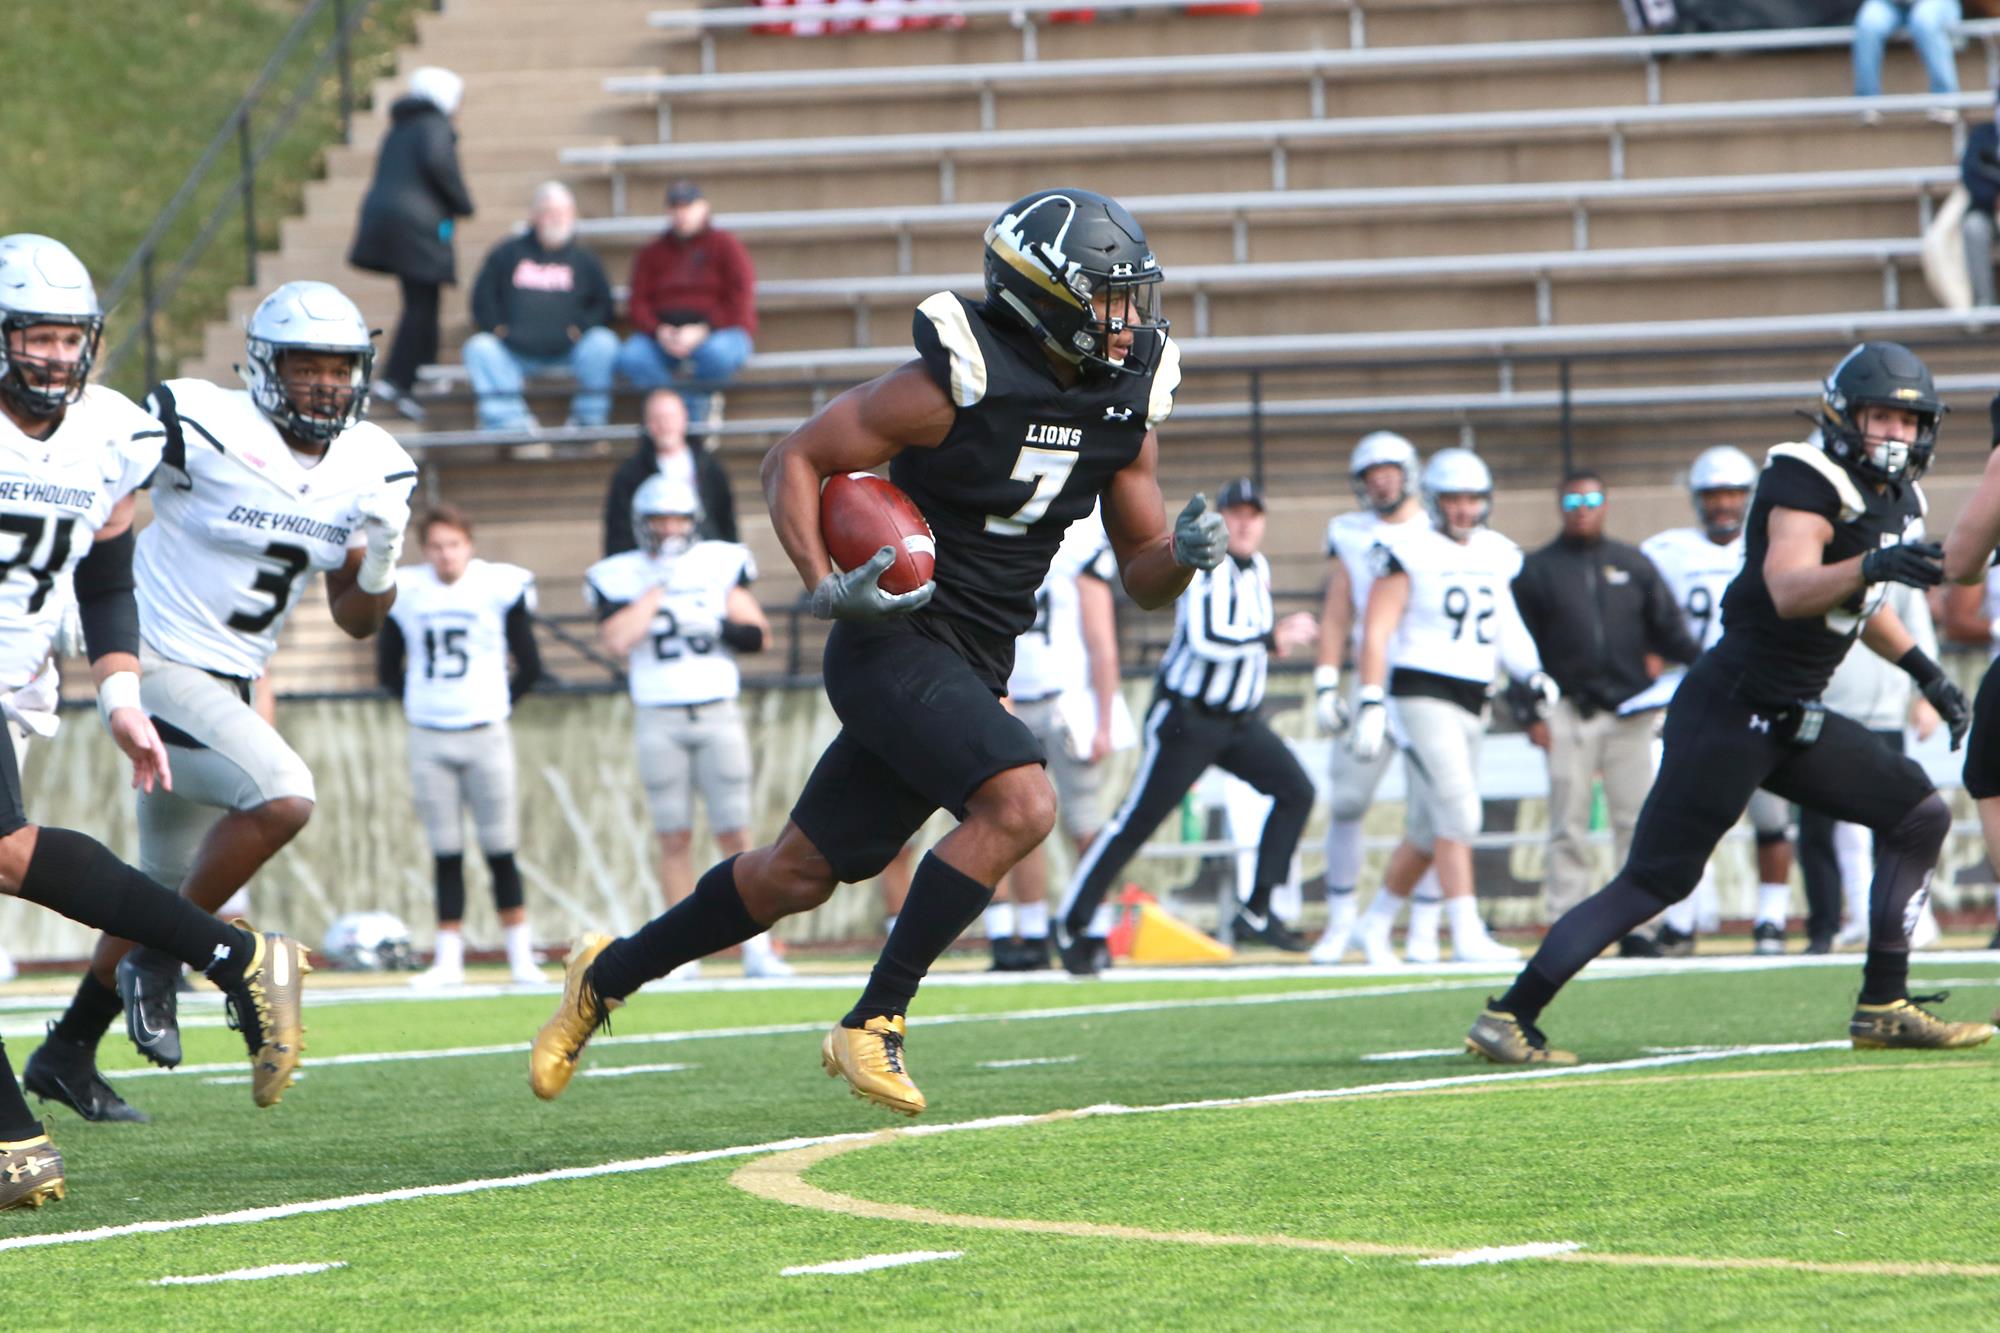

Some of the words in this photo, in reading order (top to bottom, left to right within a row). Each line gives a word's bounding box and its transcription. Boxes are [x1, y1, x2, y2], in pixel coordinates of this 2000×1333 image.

[1025, 423, 1083, 446] LIONS
[984, 446, 1080, 536] 7
[227, 505, 351, 545] GREYHOUNDS
[226, 541, 309, 633] 3
[1444, 586, 1495, 644] 92
[425, 628, 469, 679] 15
